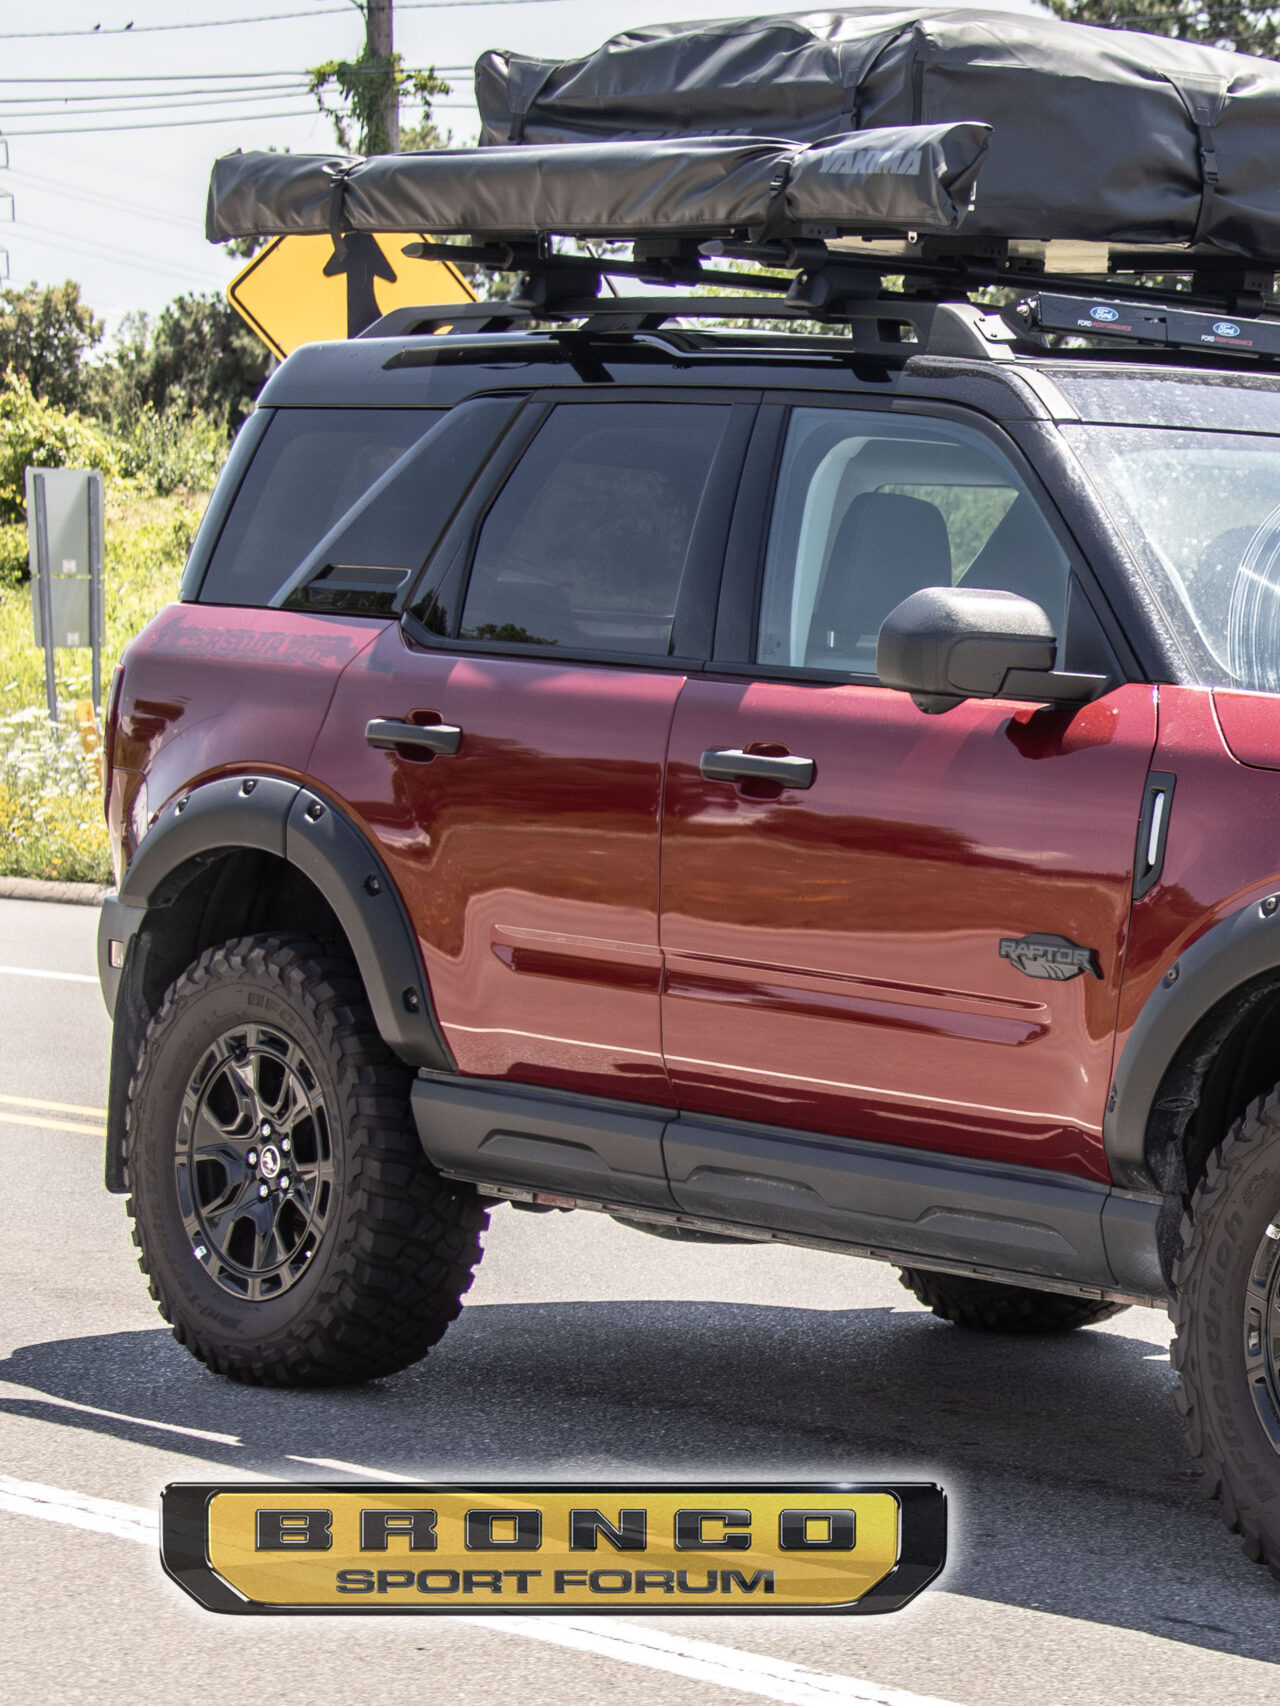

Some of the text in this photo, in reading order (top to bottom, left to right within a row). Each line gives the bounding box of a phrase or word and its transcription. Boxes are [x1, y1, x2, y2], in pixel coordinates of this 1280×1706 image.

[819, 151, 922, 175] YAKIMA
[1094, 308, 1115, 320] Ford
[1217, 323, 1236, 335] Ford
[1000, 940, 1096, 970] RAPTOR
